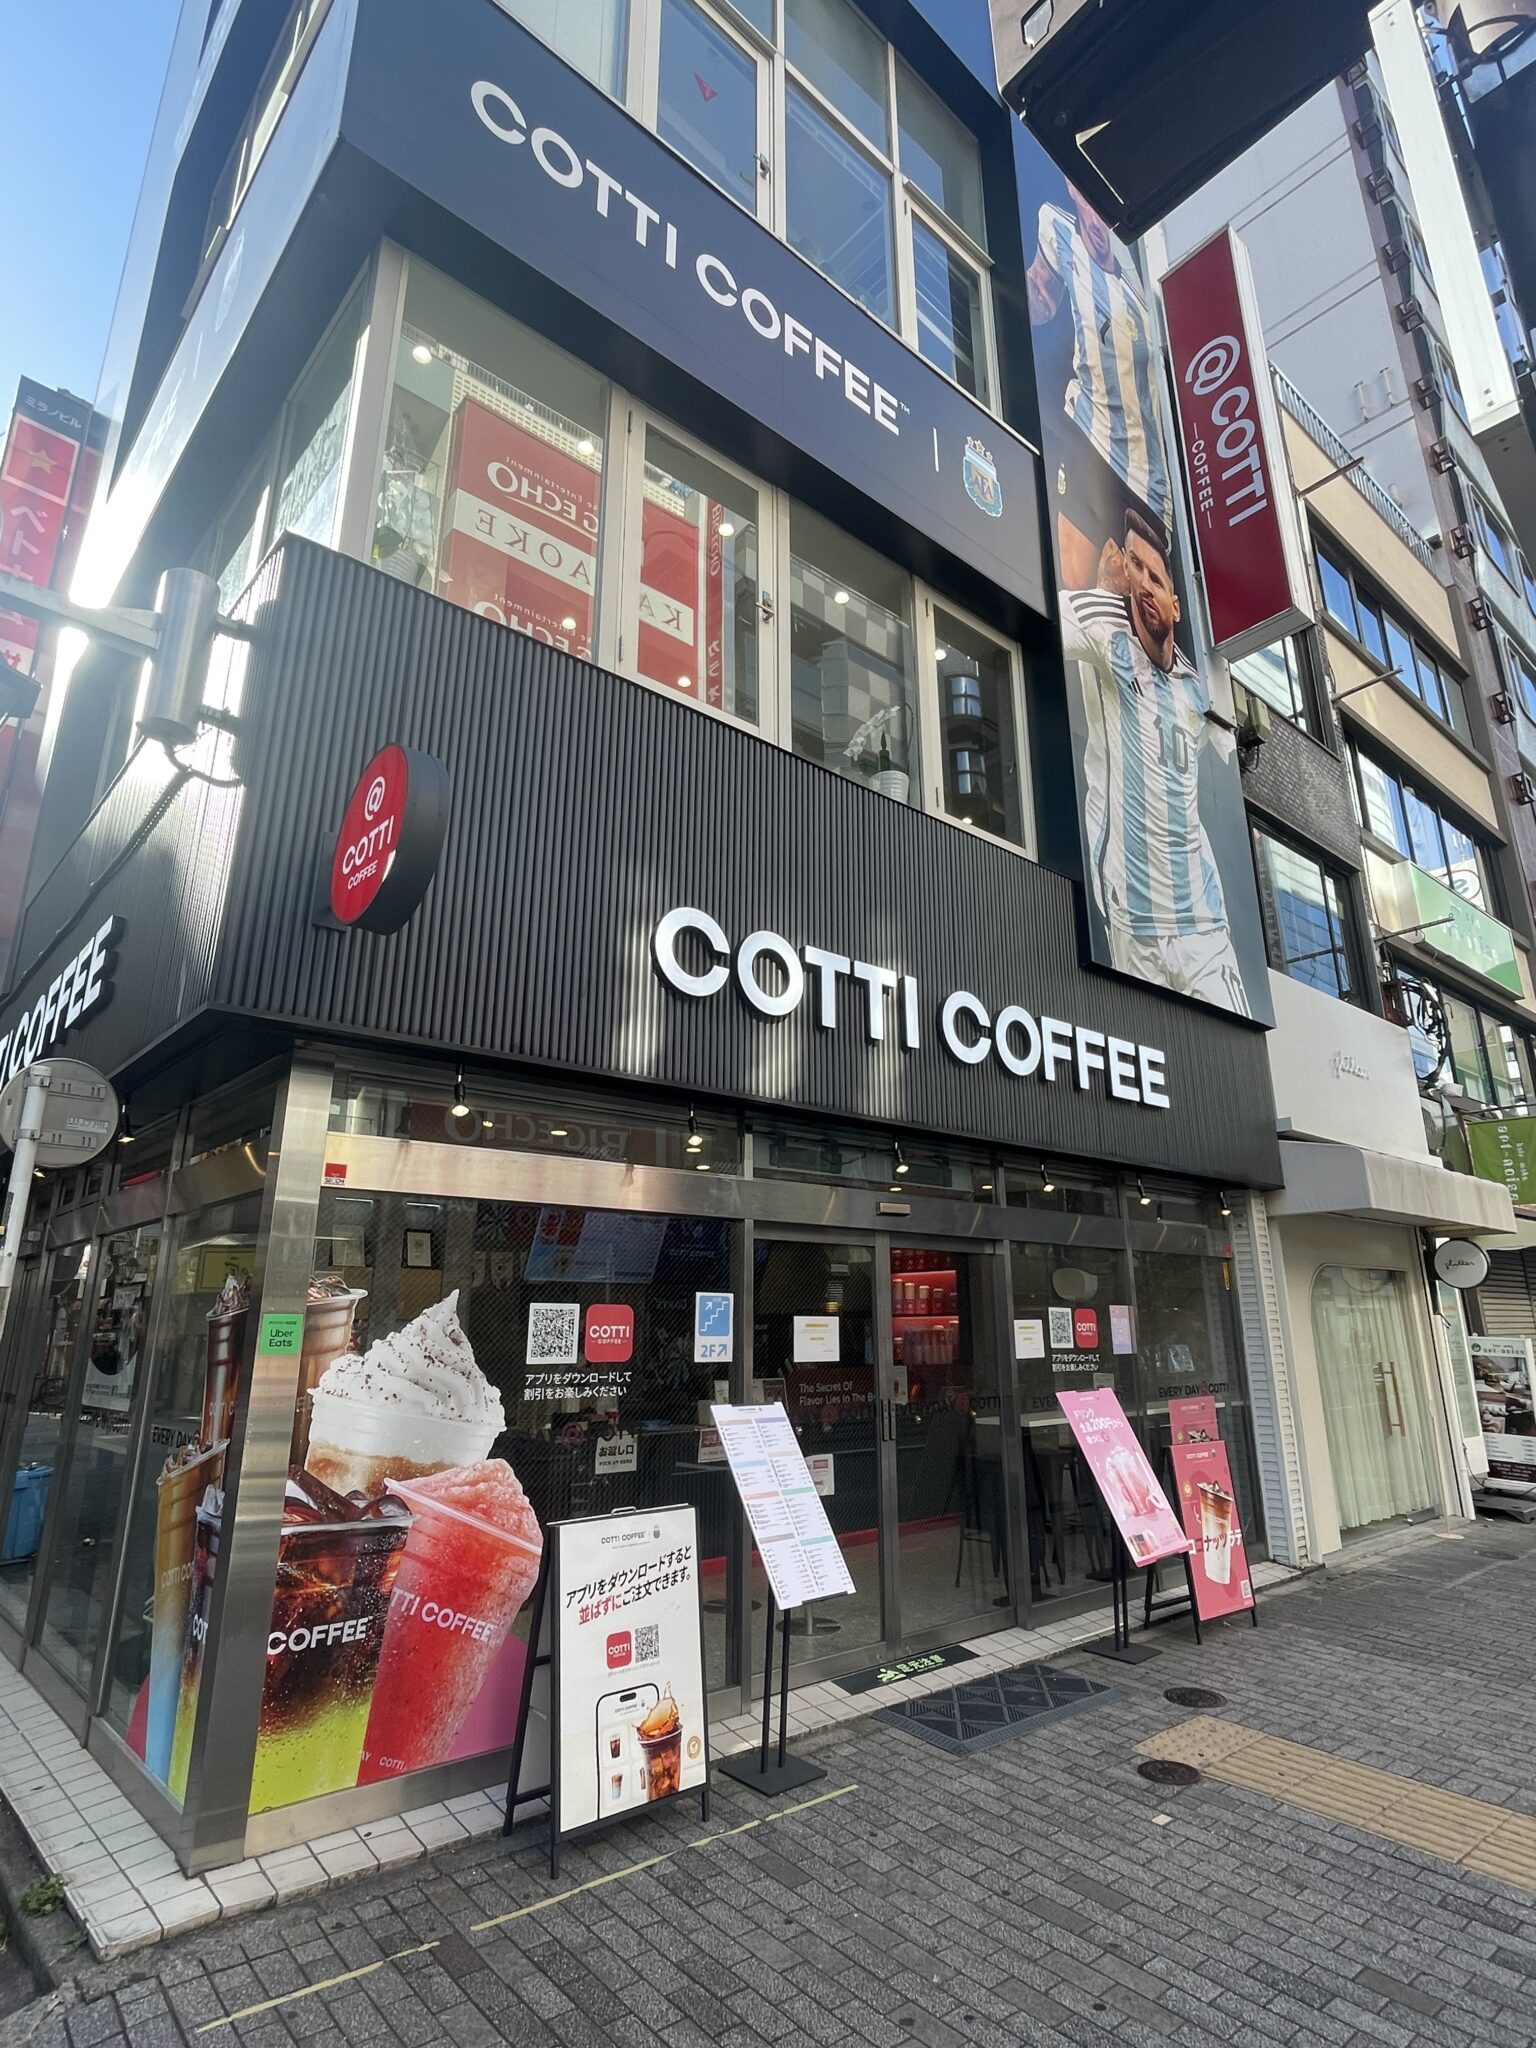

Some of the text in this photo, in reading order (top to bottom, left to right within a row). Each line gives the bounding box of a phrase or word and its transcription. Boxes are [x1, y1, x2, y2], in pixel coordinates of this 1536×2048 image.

[470, 80, 678, 270] COTTI
[1210, 386, 1268, 527] COTTI
[1191, 439, 1214, 512] COFFEE
[1153, 714, 1188, 775] 10
[342, 815, 395, 875] COTTI
[347, 859, 379, 890] COFFEE
[8, 914, 114, 1081] COFFEE
[654, 906, 1170, 1109] COTTI COFFEE
[270, 1329, 294, 1338] Uber
[589, 1325, 630, 1339] COTTI
[1076, 1322, 1097, 1331] COTTI
[268, 1338, 293, 1347] Eats
[700, 1344, 716, 1358] 2F
[525, 1371, 632, 1385] アプリをダウンロードして
[523, 1386, 627, 1400] 割引をお楽しみください
[1158, 1384, 1182, 1398] EVERY
[1185, 1383, 1201, 1395] DAY
[1209, 1382, 1229, 1394] COTTI
[600, 1535, 620, 1545] COTTI
[566, 1545, 692, 1609] アプリをダウンロードすると
[421, 1602, 496, 1643] COFFEE
[267, 1617, 369, 1656] COFFEE
[607, 1643, 631, 1655] COTTI
[379, 1756, 405, 1770] COTTI
